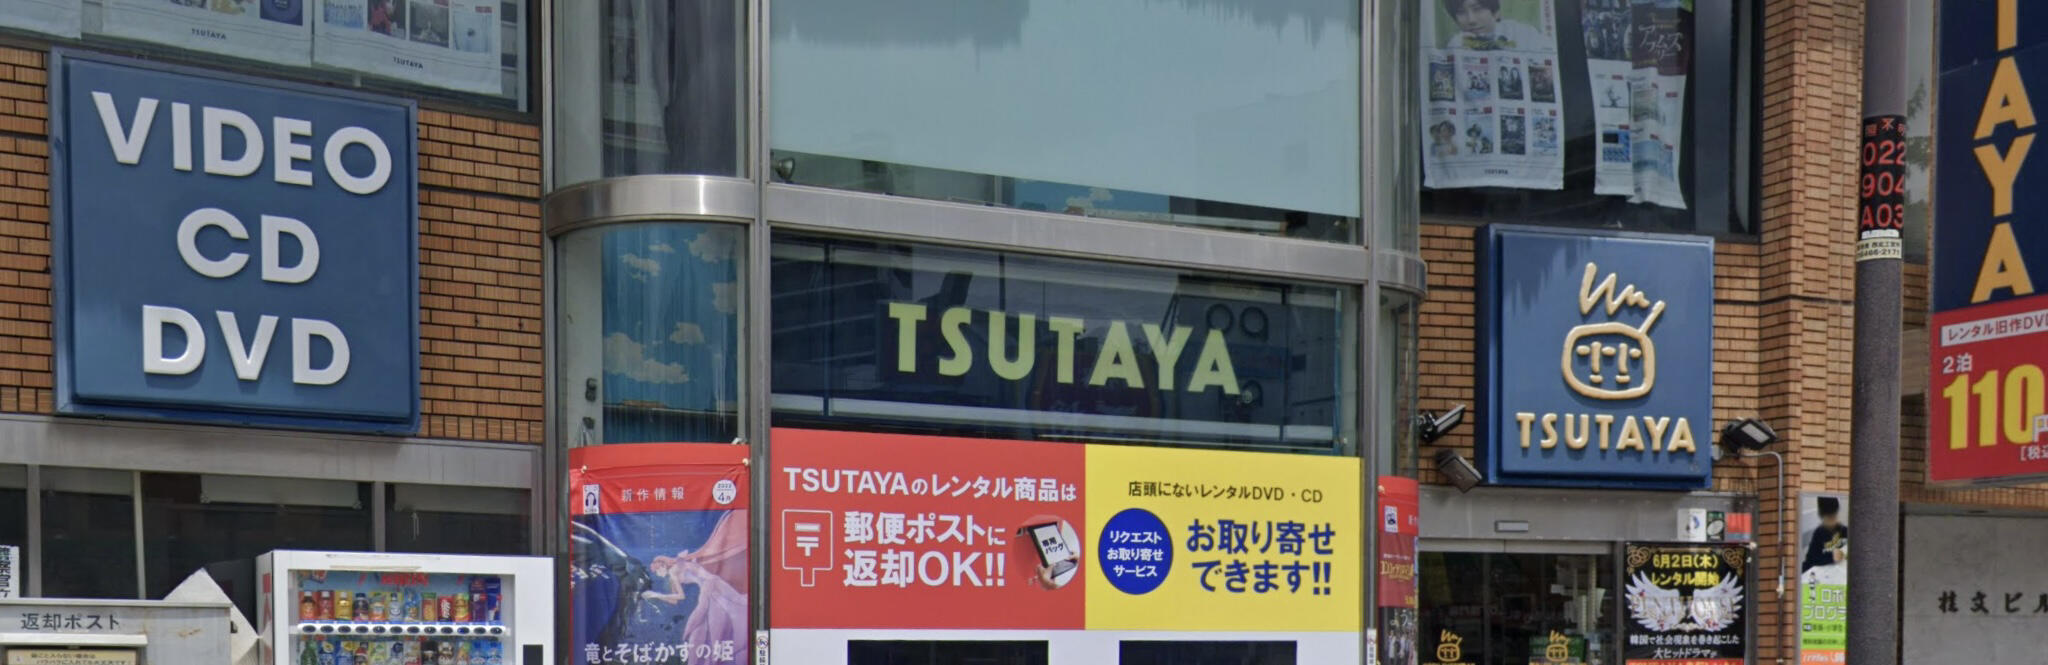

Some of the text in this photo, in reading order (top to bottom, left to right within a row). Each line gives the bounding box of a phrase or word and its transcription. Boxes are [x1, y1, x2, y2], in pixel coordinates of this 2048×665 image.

[191, 28, 227, 40] TSUTAYA
[392, 56, 424, 70] TSUTAYA
[91, 91, 392, 195] VIDEO
[1863, 140, 1906, 166] 022
[1862, 171, 1905, 198] 904
[177, 208, 320, 284] CD
[143, 305, 352, 387] DVD
[889, 302, 1240, 395] TSUTAYA
[1943, 353, 1973, 374] 2泊
[1516, 412, 1696, 452] TSUTAYA
[621, 486, 685, 502] 新作情報
[783, 467, 1077, 502] TSUTAYAのレンタル商品は
[843, 511, 1006, 545] 郵便ポストに
[1109, 530, 1163, 544] リクエスト
[1186, 518, 1336, 555] お取り寄せ
[1107, 547, 1164, 561] お取り寄せ
[842, 548, 1006, 588] 返却OK!!
[1113, 565, 1158, 577] サービス
[1191, 559, 1332, 596] できます!!
[1652, 571, 1720, 586] レンタル開始
[21, 613, 120, 630] 返却ポスト
[584, 640, 734, 664] 竜とそばかすの姫
